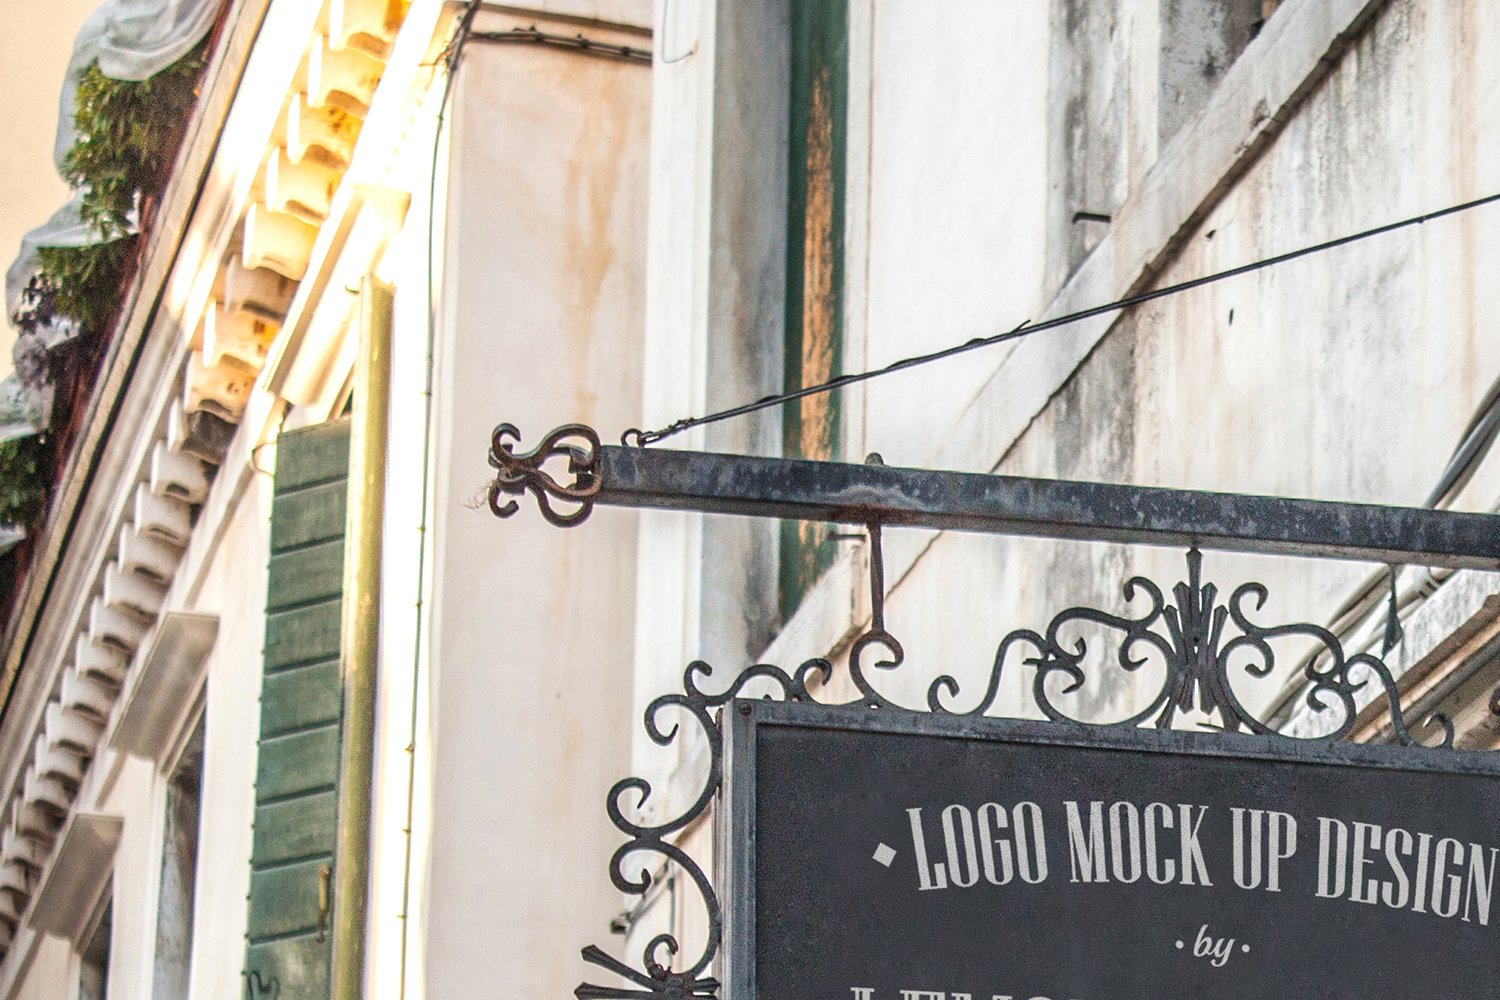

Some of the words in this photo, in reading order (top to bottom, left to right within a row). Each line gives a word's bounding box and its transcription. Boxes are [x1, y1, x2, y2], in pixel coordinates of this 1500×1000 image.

[905, 801, 1049, 891] LOGO
[1062, 800, 1214, 887] MOCK
[1229, 807, 1299, 892] UP
[1314, 816, 1500, 926] DESIGN
[1193, 924, 1236, 968] by
